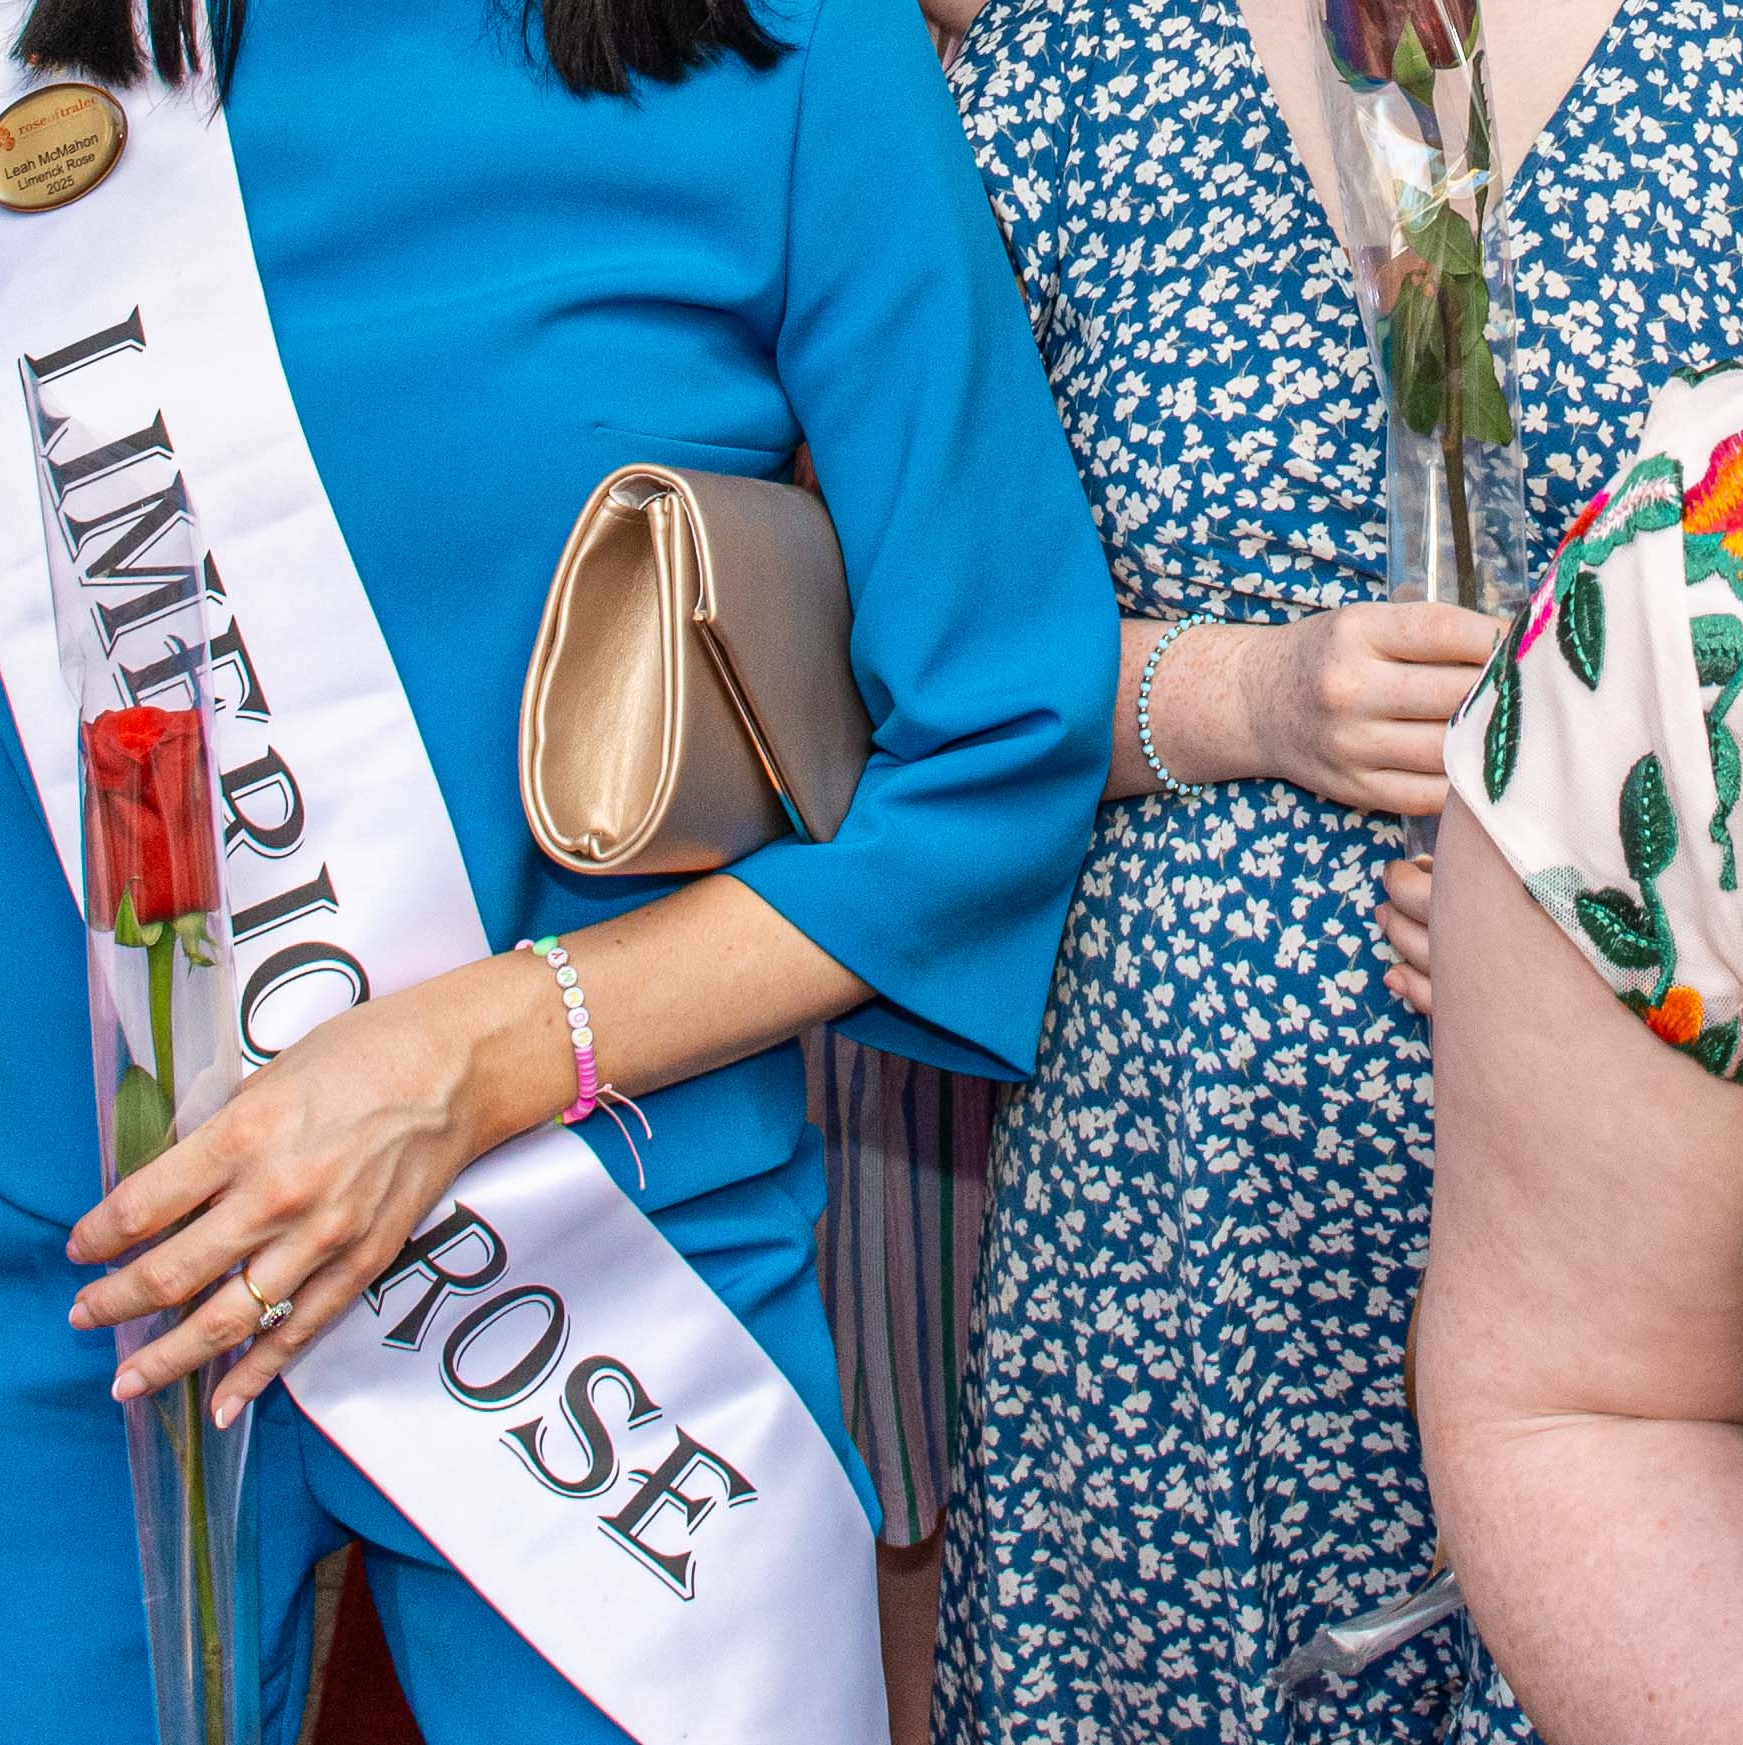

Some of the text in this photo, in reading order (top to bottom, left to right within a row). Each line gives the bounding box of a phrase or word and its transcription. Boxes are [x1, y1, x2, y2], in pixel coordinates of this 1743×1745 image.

[5, 132, 99, 180] Leah McMahon
[18, 152, 96, 191] Limerick Rose
[46, 175, 75, 196] 2025
[362, 1199, 758, 1602] ROSE
